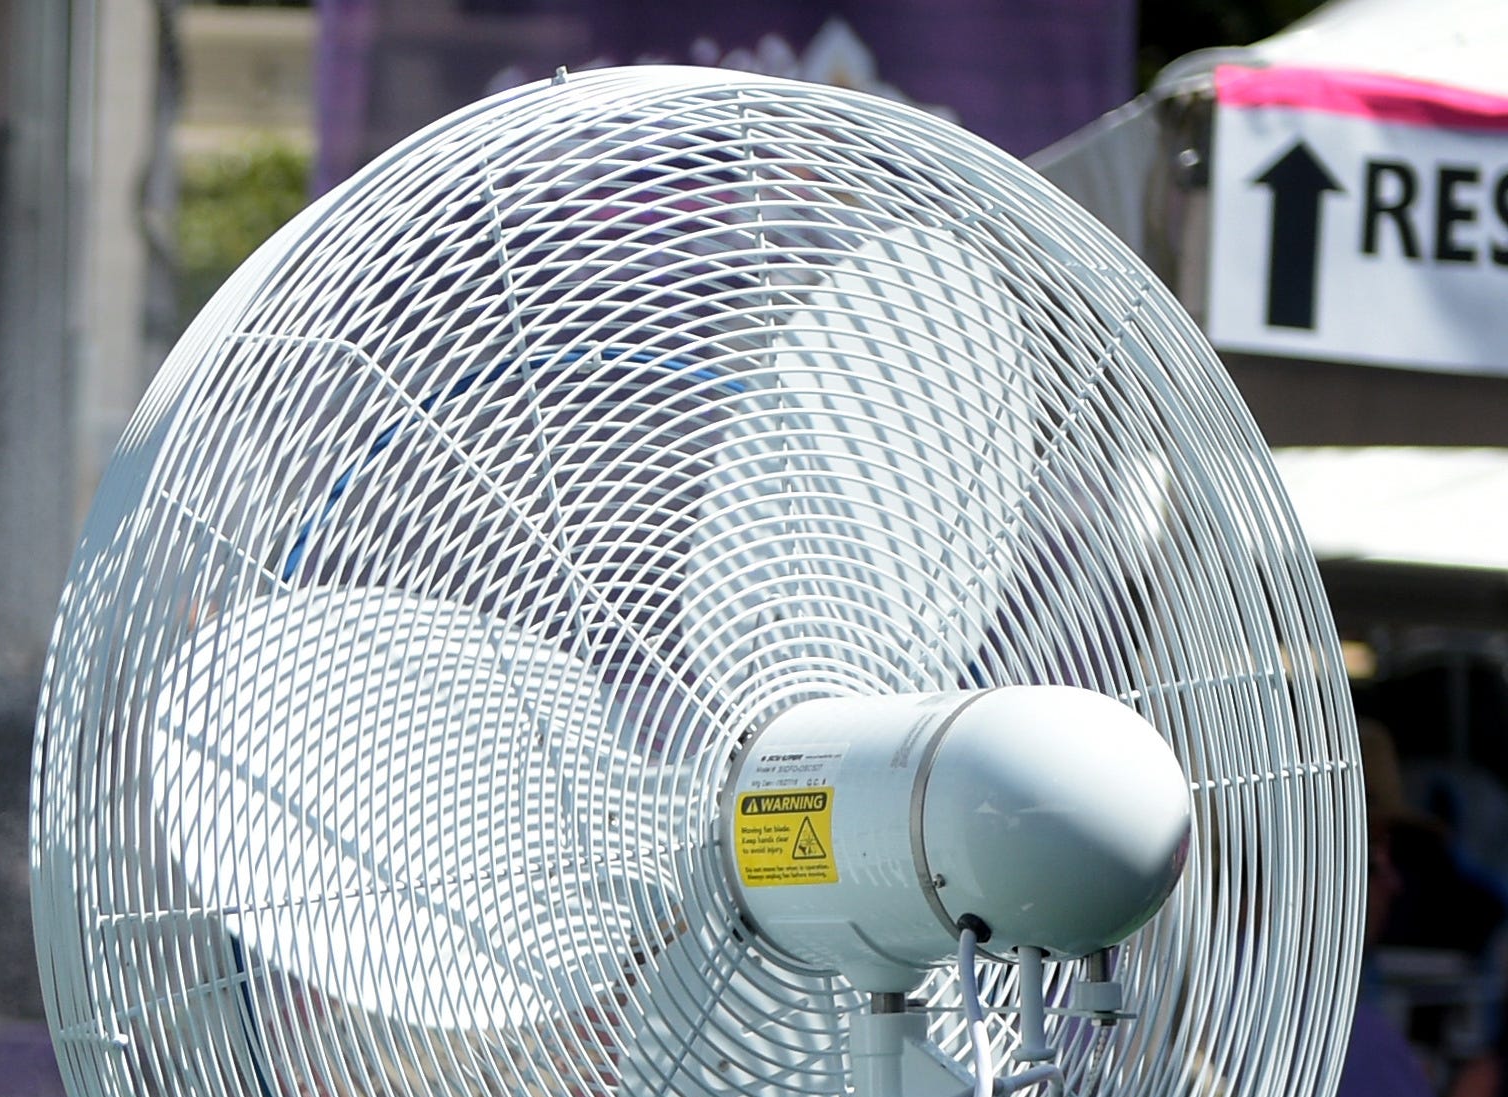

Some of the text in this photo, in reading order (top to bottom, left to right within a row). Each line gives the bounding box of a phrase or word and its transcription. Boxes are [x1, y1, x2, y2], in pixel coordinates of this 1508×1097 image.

[760, 795, 823, 812] WARNING
[741, 827, 762, 835] Moving
[742, 837, 756, 845] Keep
